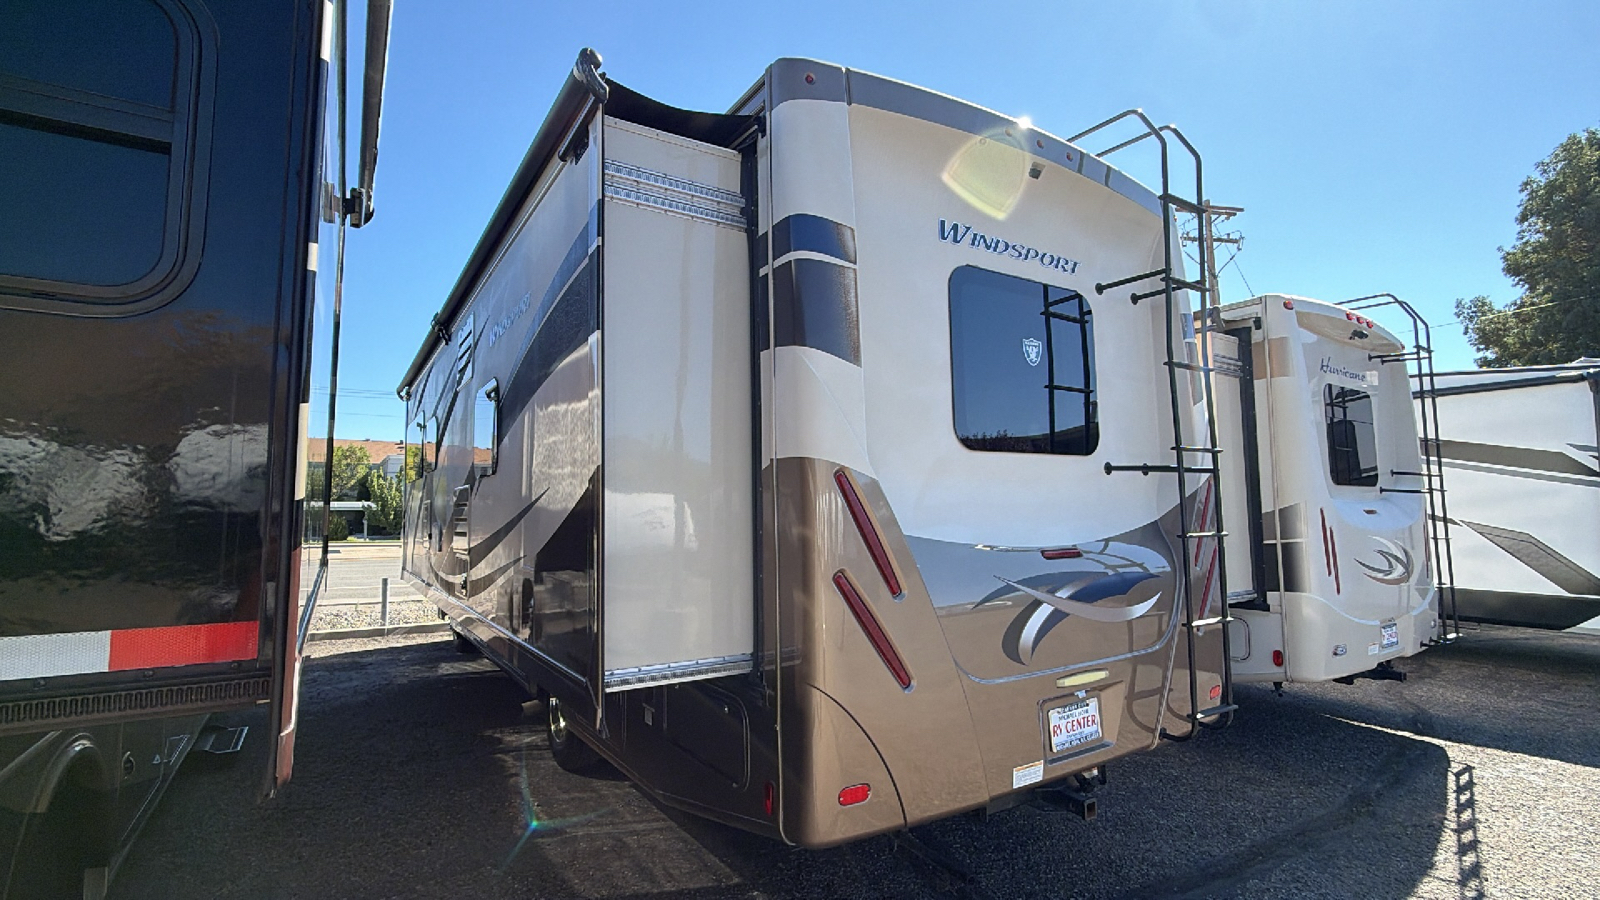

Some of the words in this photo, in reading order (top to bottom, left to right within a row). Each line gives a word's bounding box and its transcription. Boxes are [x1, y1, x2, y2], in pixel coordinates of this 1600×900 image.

[938, 217, 1082, 276] WINDSPORT
[1320, 356, 1366, 381] Hurricane
[1052, 724, 1062, 738] RV
[1065, 714, 1097, 734] CENTER
